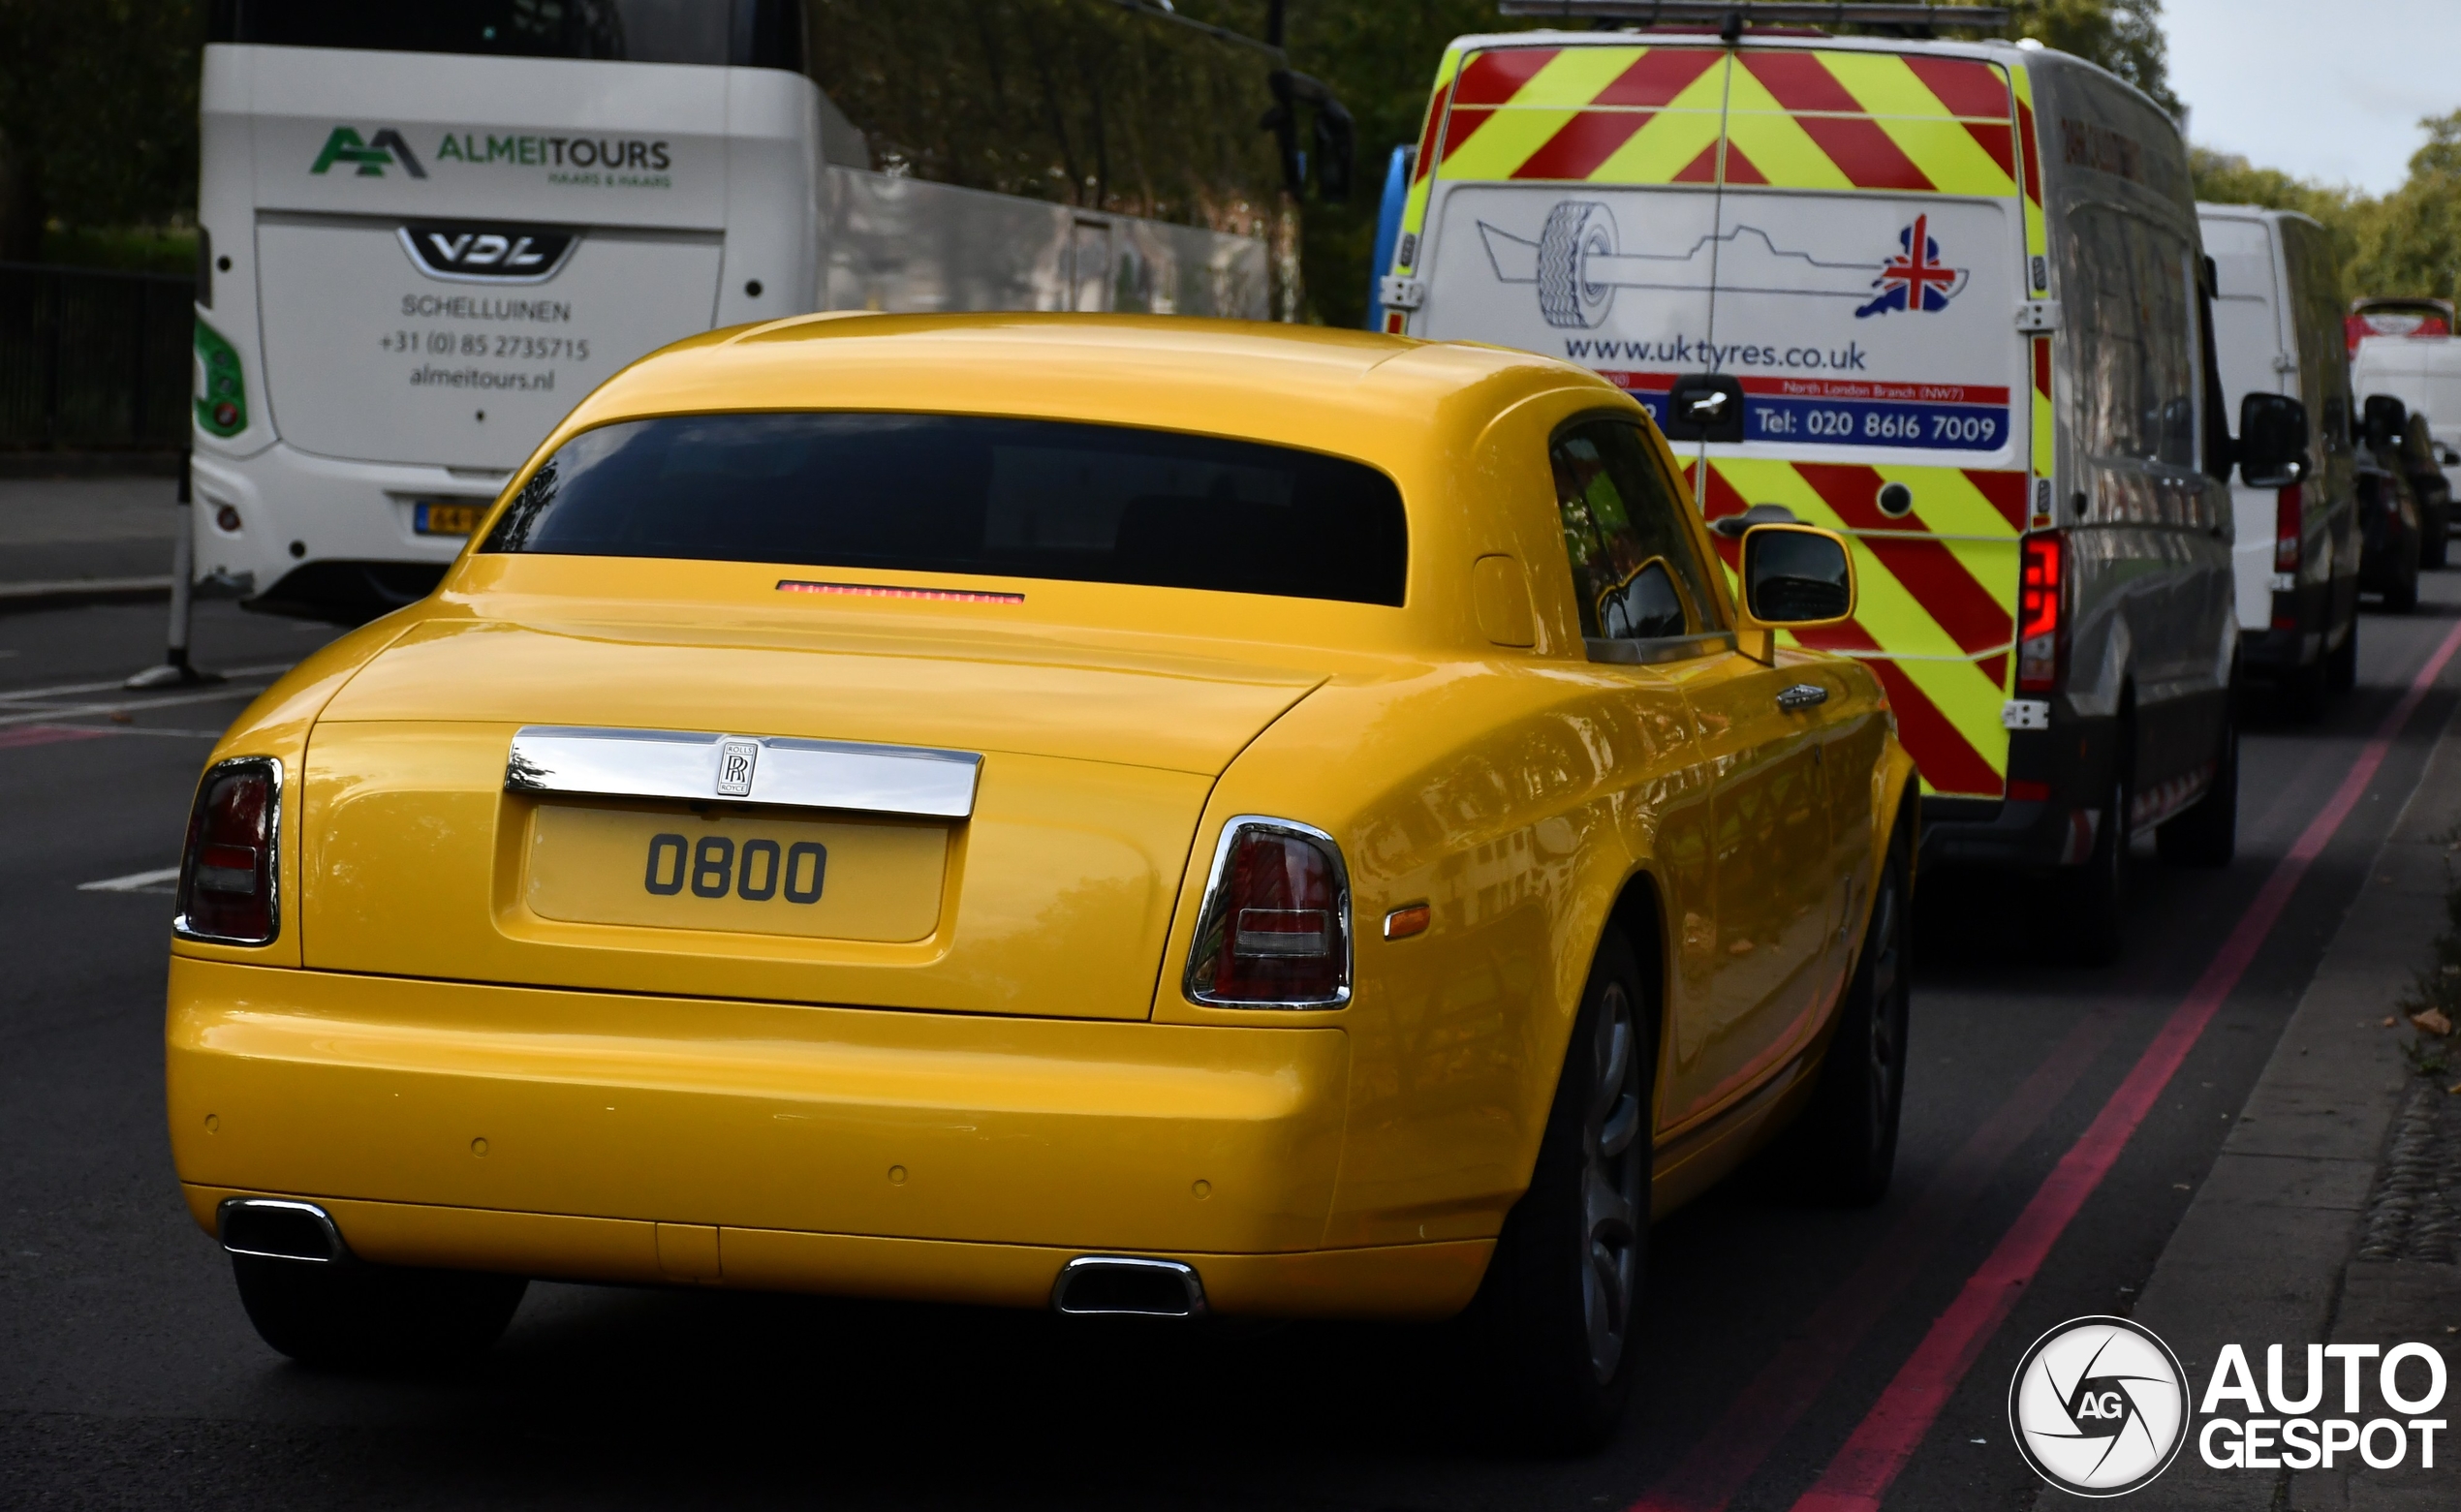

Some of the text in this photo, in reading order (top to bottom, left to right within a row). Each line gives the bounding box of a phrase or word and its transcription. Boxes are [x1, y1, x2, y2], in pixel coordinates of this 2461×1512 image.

[437, 133, 671, 171] ALMEITOURS
[428, 232, 545, 267] VDL
[402, 293, 572, 323] SCHELLUINEN
[379, 330, 590, 361] +31 (0) 85 2735715
[1566, 333, 1866, 372] www.uktyres.co.uk
[409, 362, 555, 391] almeitours.nl
[1783, 382, 1966, 402] North London Branch (NW7)
[1756, 408, 1997, 443] Tel: 020 8616 7009
[725, 755, 749, 783] RR
[644, 833, 827, 904] 0800
